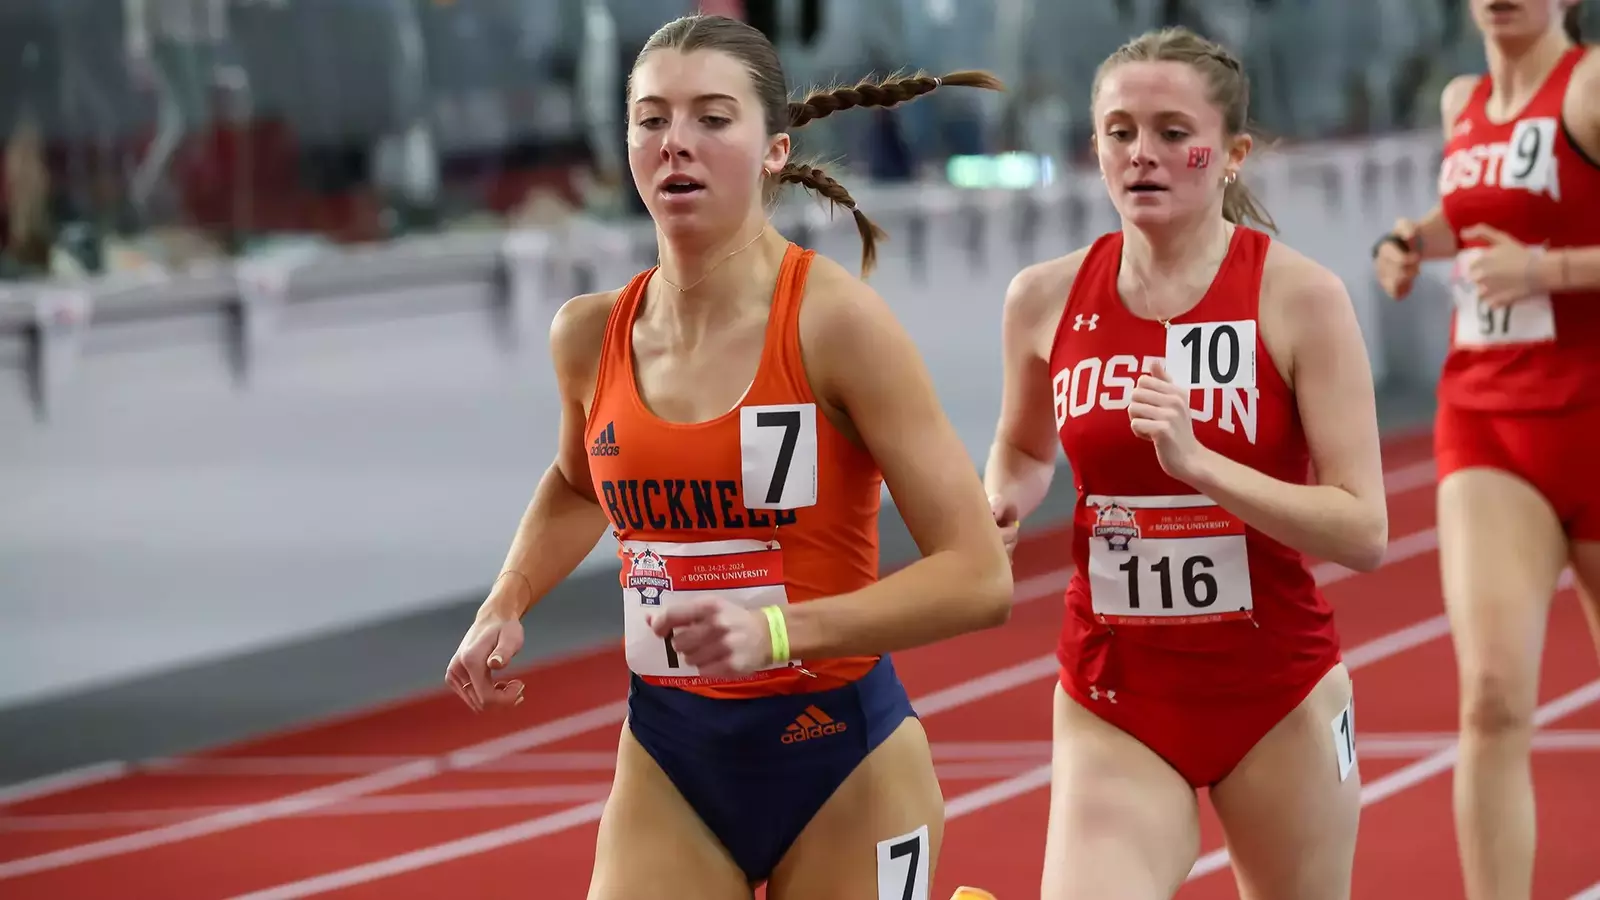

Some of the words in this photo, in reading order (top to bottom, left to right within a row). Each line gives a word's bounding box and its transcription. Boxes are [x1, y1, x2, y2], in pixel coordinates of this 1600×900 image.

[1513, 125, 1541, 179] 9
[1180, 324, 1240, 385] 10
[756, 410, 801, 504] 7
[1155, 523, 1185, 532] BOSTON
[1186, 520, 1231, 531] UNIVERSITY
[688, 572, 720, 582] BOSTON
[721, 569, 769, 580] UNIVERSITY
[1118, 555, 1218, 609] 116
[780, 721, 848, 745] adidas
[890, 836, 920, 900] 7
